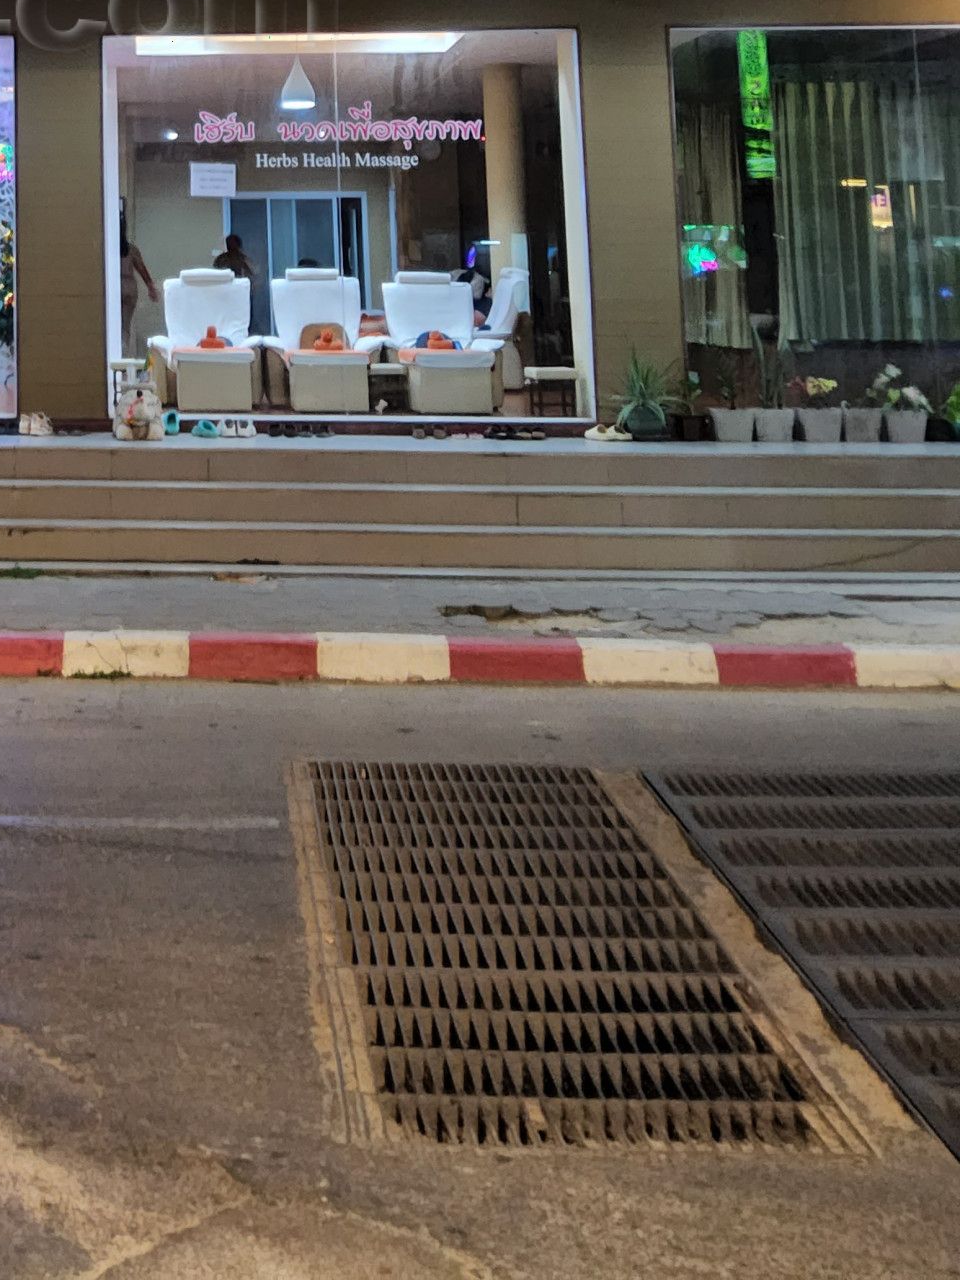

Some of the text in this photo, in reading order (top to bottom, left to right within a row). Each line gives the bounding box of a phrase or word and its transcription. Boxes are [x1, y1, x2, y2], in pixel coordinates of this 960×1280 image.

[277, 100, 483, 151] นวดเพื่อสุขภาพ
[255, 152, 419, 170] Herbs Health Massage
